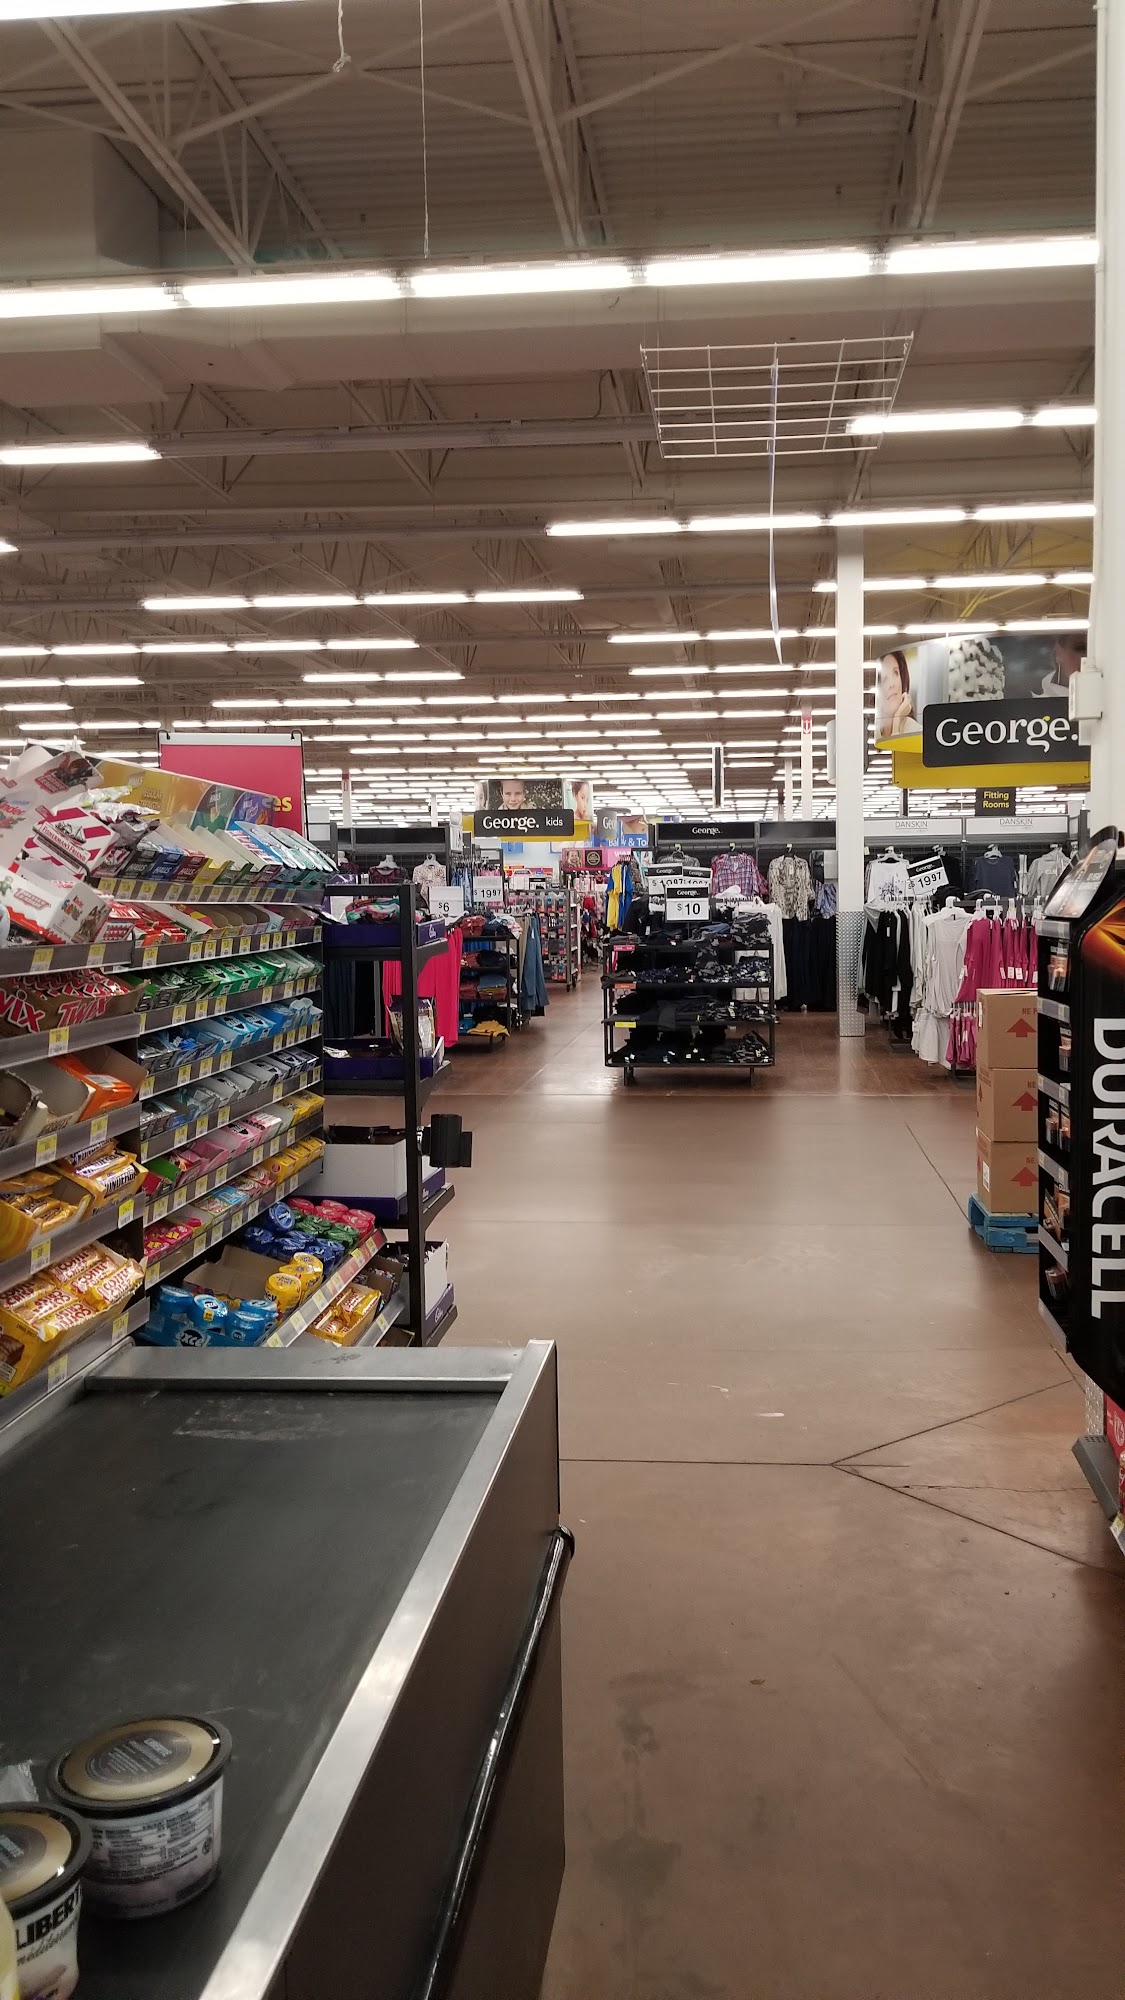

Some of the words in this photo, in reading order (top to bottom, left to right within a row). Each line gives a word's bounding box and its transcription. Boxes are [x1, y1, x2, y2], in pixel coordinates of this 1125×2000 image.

[935, 715, 1078, 753] George.
[983, 791, 1009, 801] Fitting
[482, 816, 540, 833] George.
[545, 816, 563, 826] kids
[895, 820, 928, 828] DANSKIN
[999, 818, 1033, 826] DANSKIN
[638, 837, 647, 847] To
[68, 846, 87, 861] FRIEND
[0, 989, 45, 1033] WIX
[1091, 1018, 1125, 1319] DURACELL
[16, 1887, 79, 1951] LIBERT
